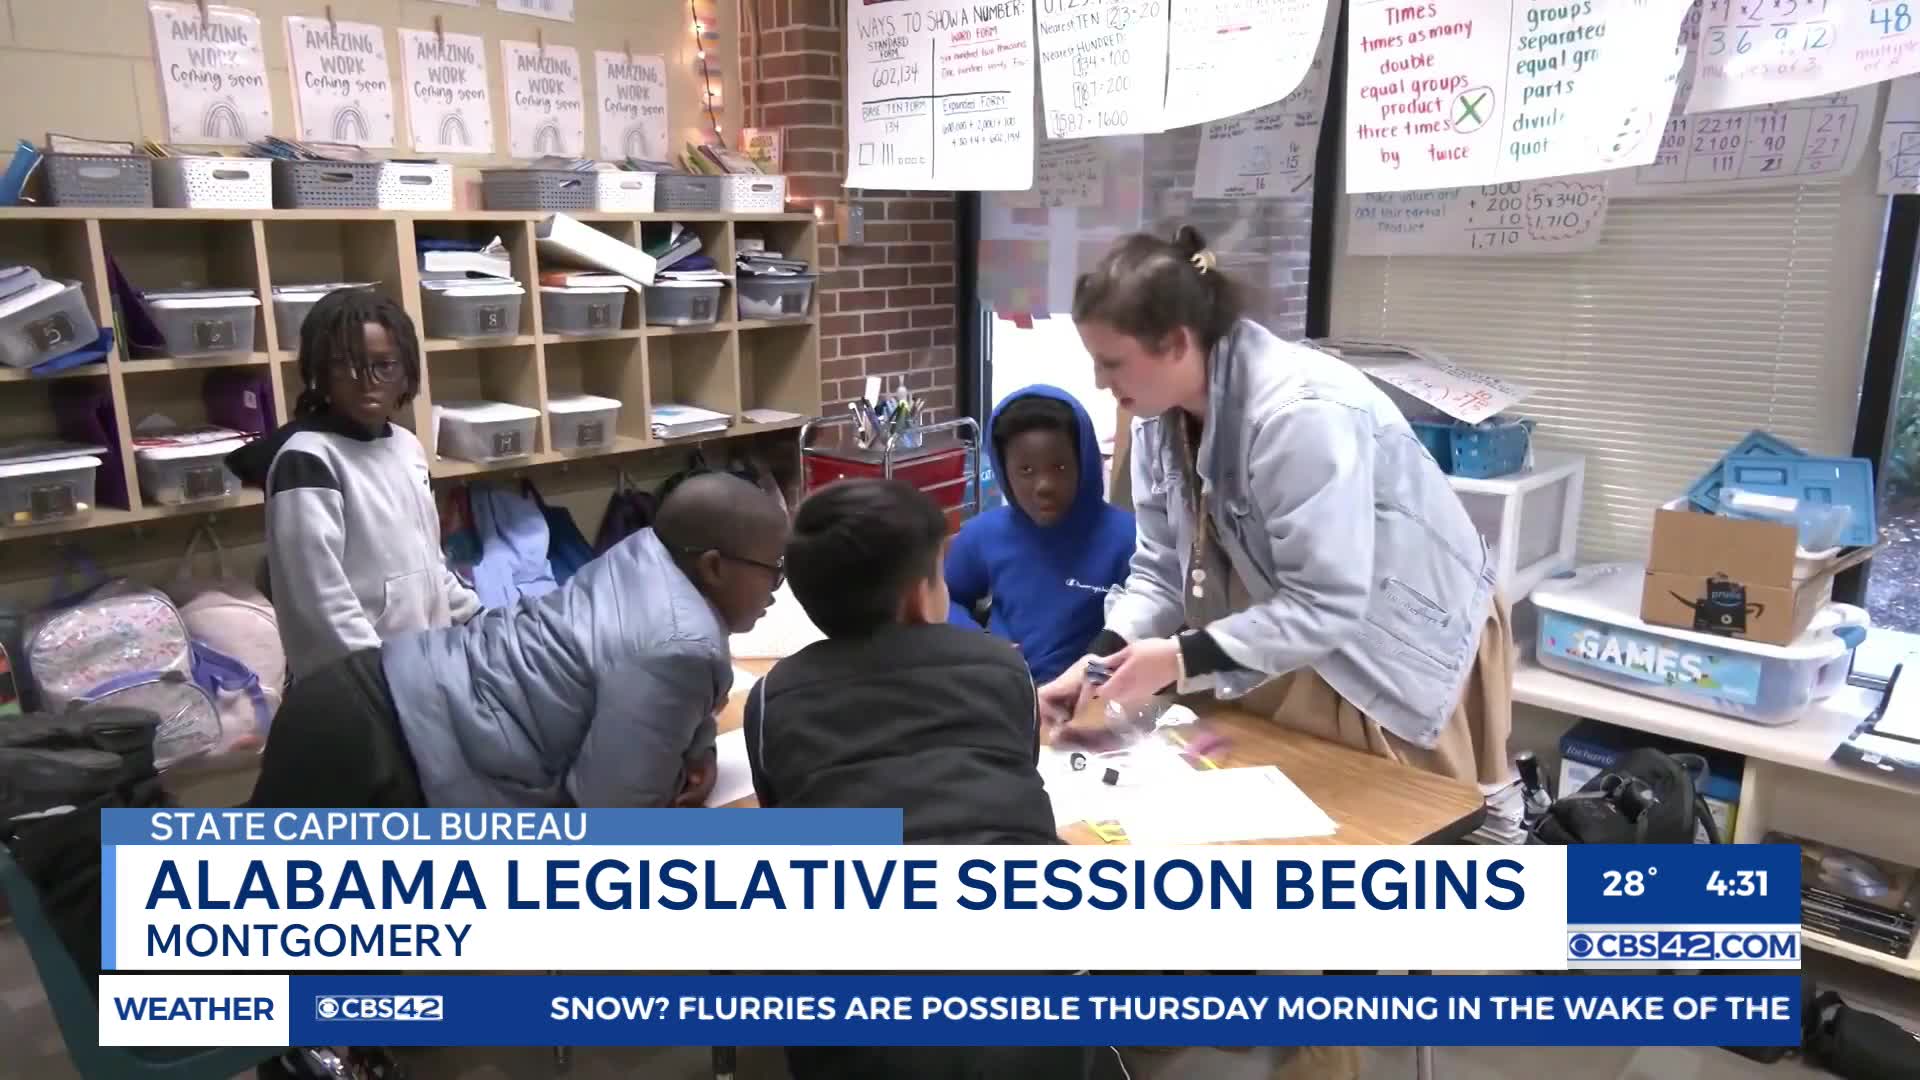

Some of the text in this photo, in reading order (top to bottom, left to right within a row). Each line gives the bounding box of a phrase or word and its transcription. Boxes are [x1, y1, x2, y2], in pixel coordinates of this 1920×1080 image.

[857, 15, 896, 40] WAYS
[904, 12, 922, 33] TO
[927, 9, 958, 32] SHOW
[961, 8, 969, 25] A
[1527, 0, 1592, 32] groups
[1870, 3, 1912, 34] 48
[171, 20, 248, 45] AMAZING
[305, 30, 373, 53] AMAZING
[867, 36, 909, 52] STANDARD
[1360, 19, 1473, 53] times as many
[1736, 30, 1752, 54] 6
[320, 56, 366, 75] WORK
[417, 42, 475, 65] AMAZING
[1380, 53, 1435, 75] double
[1516, 49, 1566, 78] equal
[171, 64, 263, 91] Coming soon
[305, 71, 386, 96] Coming soon
[428, 67, 468, 85] WORK
[528, 78, 565, 94] WORK
[872, 63, 919, 88] 602,134
[1360, 73, 1470, 103] equal groups
[414, 80, 485, 104] Coming soon
[1523, 79, 1575, 105] parts
[1381, 97, 1442, 120] product
[1357, 118, 1451, 140] three times
[1380, 144, 1471, 170] by twice
[1579, 629, 1703, 685] GAMES
